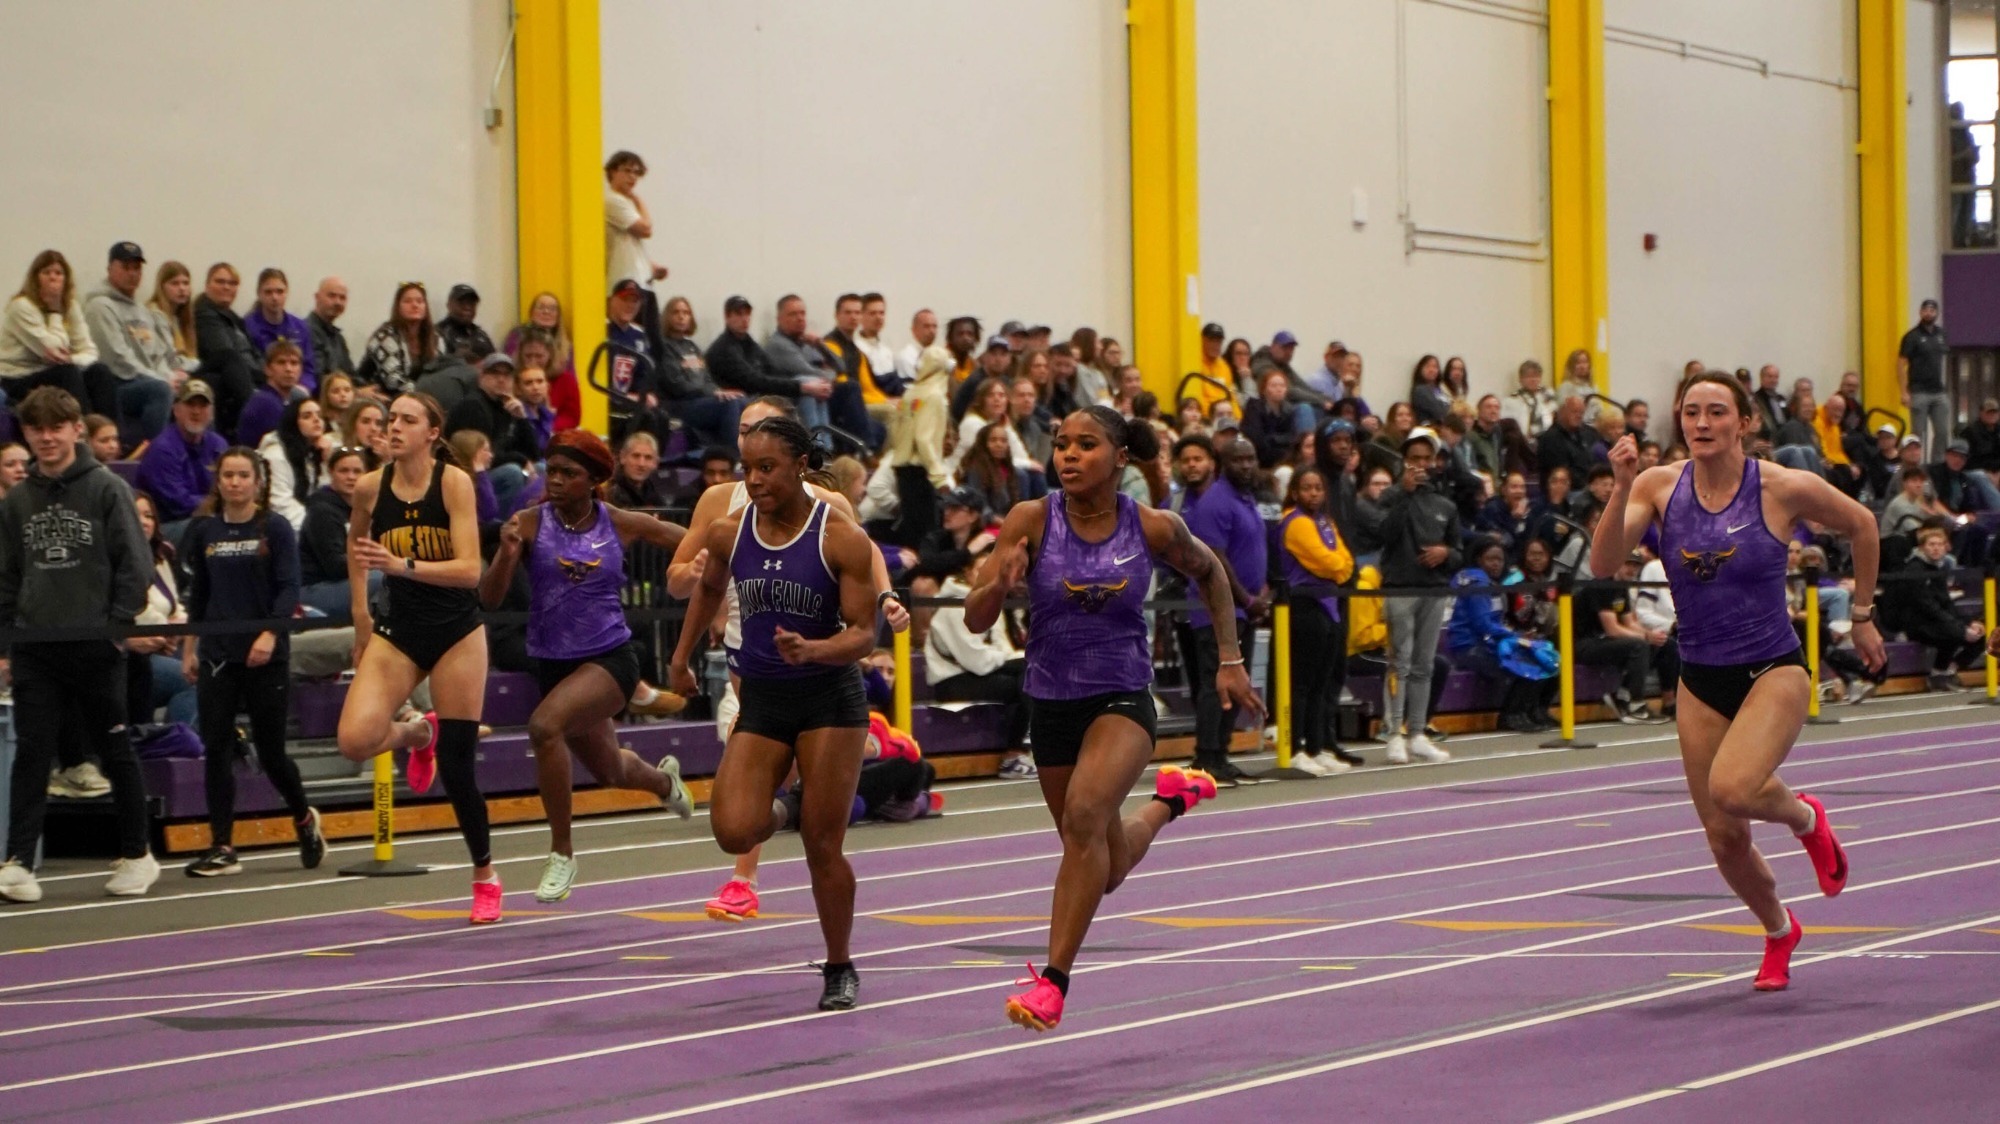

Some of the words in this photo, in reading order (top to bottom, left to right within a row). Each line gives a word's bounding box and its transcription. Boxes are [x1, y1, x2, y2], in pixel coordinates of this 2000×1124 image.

[22, 515, 93, 546] STATE
[736, 578, 771, 622] OUX
[771, 579, 823, 621] FALLS
